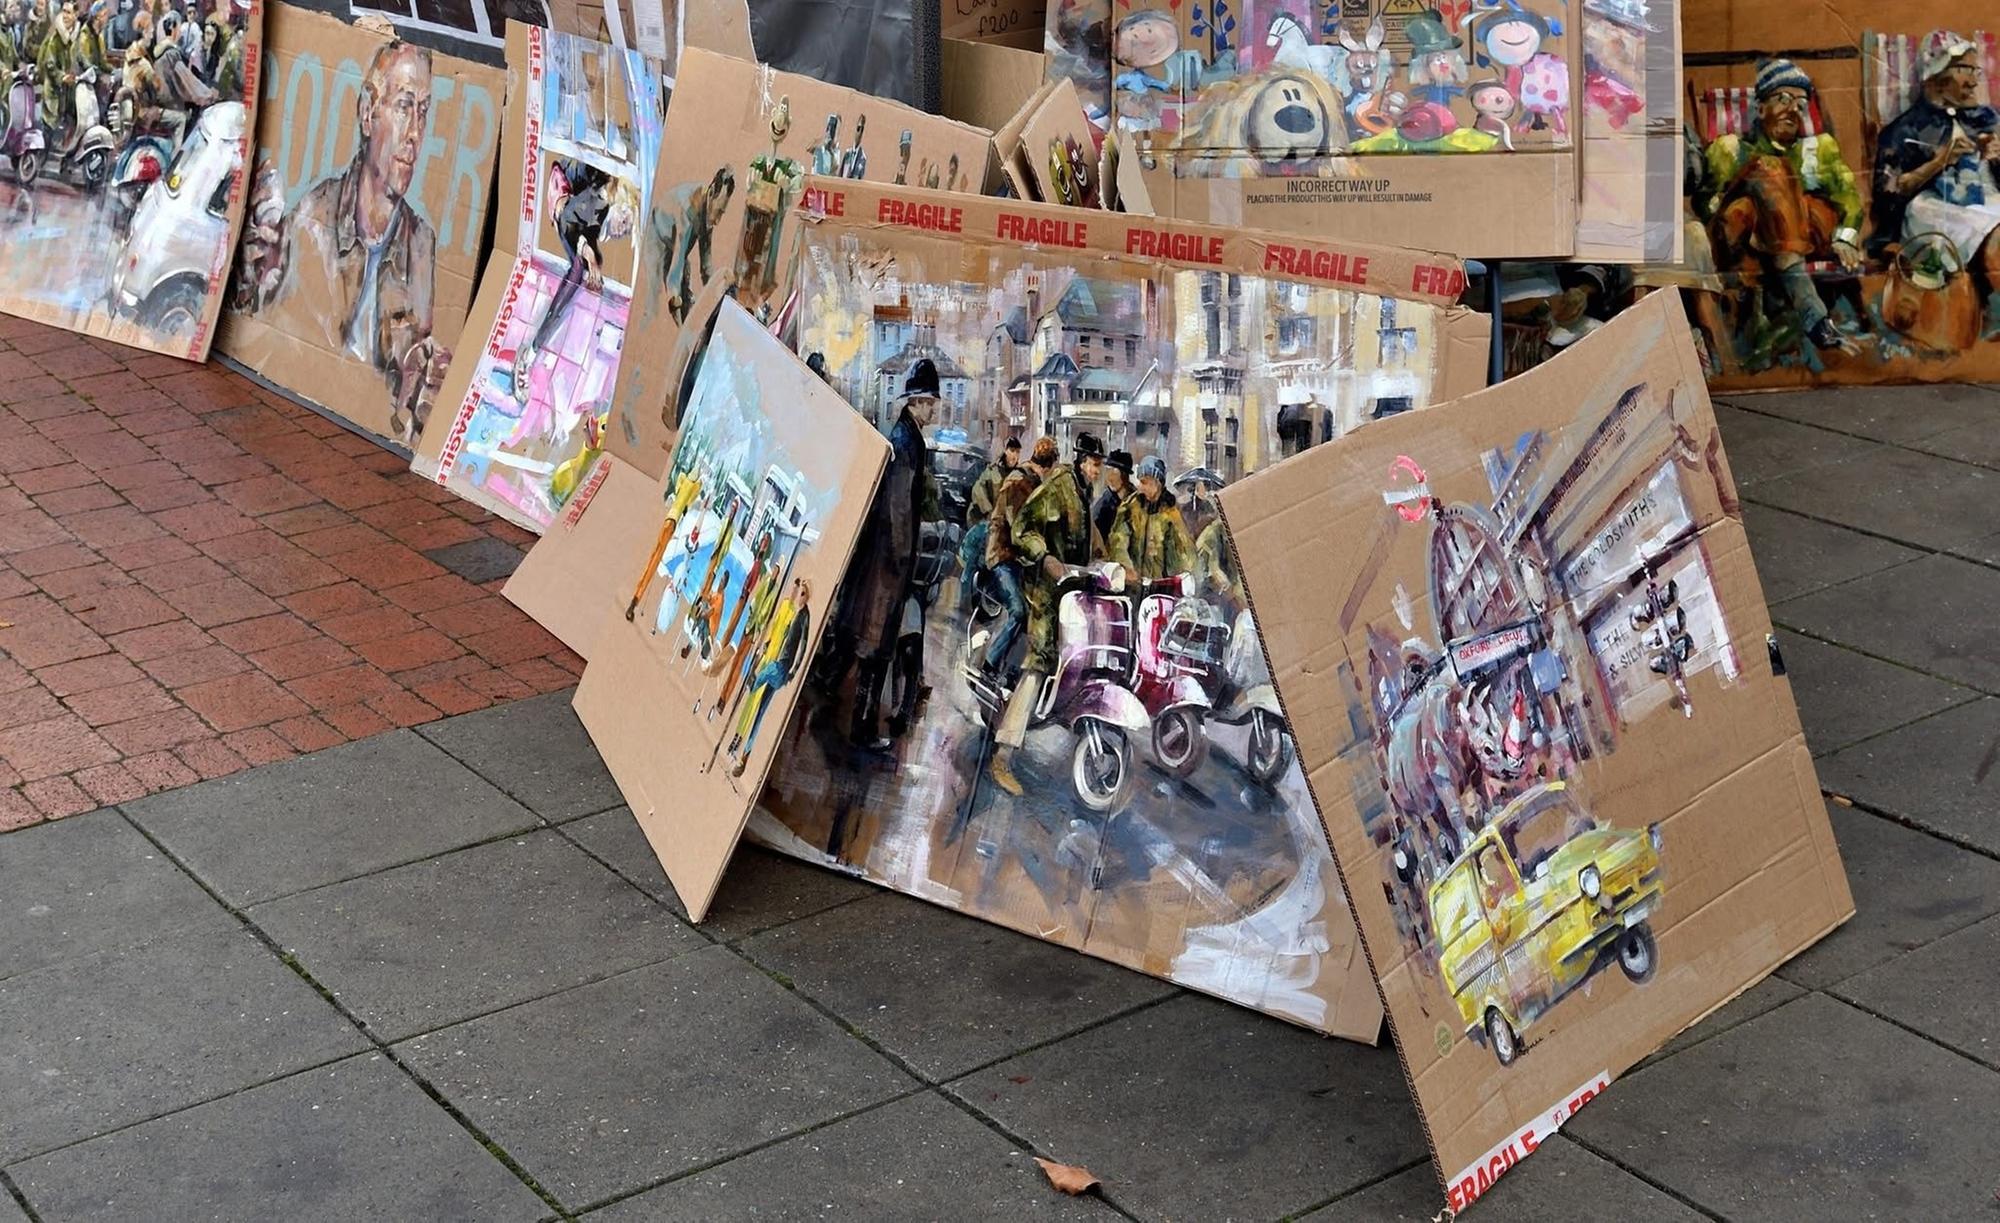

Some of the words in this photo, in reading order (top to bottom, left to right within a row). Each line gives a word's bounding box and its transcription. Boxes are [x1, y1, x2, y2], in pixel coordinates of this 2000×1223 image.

[242, 43, 258, 110] FRAGILE
[523, 119, 540, 224] FRAGILE
[1247, 194, 1274, 204] PLACING
[1275, 194, 1286, 203] THE
[1287, 194, 1317, 203] PRODUCT
[1317, 194, 1331, 203] THIS
[1332, 194, 1346, 203] WAY
[1347, 194, 1357, 203] UP
[1357, 194, 1372, 202] WILL
[1372, 193, 1396, 202] RESULT
[1396, 193, 1404, 202] IN
[1405, 193, 1433, 202] DAMAGE
[1286, 180, 1347, 193] INCORRECT
[1348, 180, 1373, 192] WAY
[1375, 180, 1390, 192] UP
[878, 198, 963, 233] FRAGILE
[997, 214, 1087, 249] FRAGILE
[1126, 228, 1224, 265] FRAGILE
[1264, 244, 1369, 285] FRAGILE
[487, 259, 532, 359] FRAGILE
[437, 391, 483, 486] FRAGILE
[1569, 564, 1588, 587] THE
